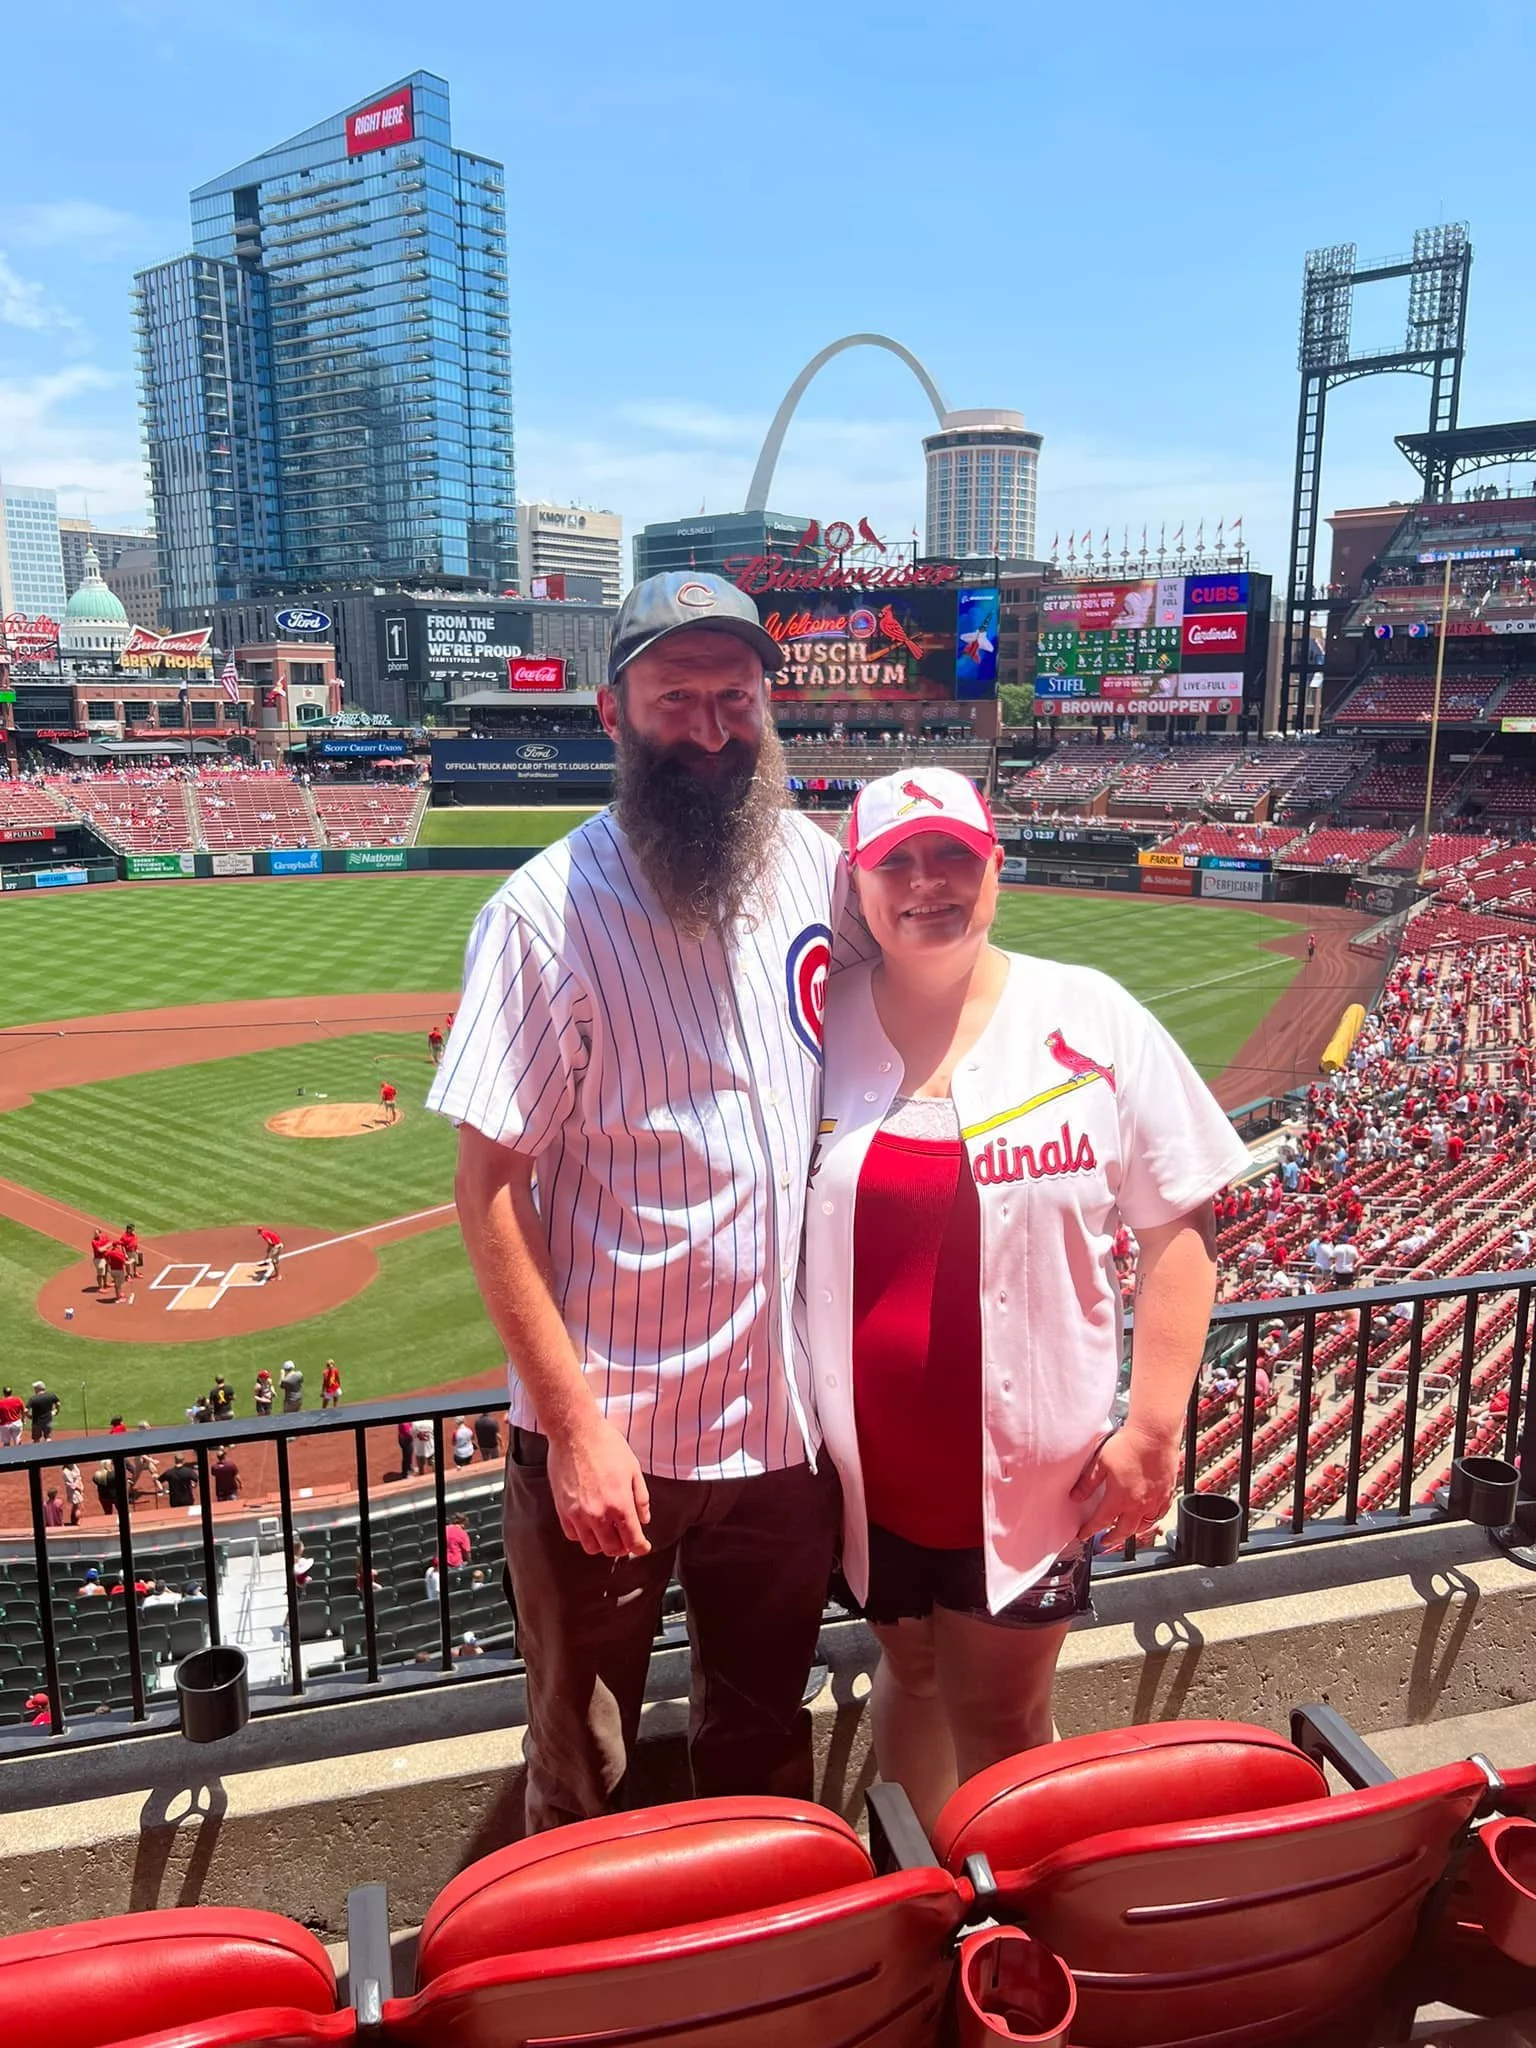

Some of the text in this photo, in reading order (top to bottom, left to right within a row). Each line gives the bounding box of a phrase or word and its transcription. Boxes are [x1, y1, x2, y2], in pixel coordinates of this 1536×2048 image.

[354, 104, 404, 136] RIGHT HERE
[539, 511, 566, 524] KMOV
[723, 553, 962, 594] Budweiser
[1061, 557, 1229, 579] WORLD CHAMPIONS
[676, 582, 716, 608] C
[1191, 586, 1240, 603] CUBS
[1043, 601, 1057, 611] GET
[1059, 601, 1070, 610] UP
[1071, 600, 1082, 609] TO
[1101, 598, 1116, 608] OFF
[288, 611, 320, 628] Ford
[427, 615, 495, 630] FROM THE
[765, 611, 848, 641] Welcome
[128, 633, 211, 651] Budweiser
[427, 629, 487, 643] LOU AND
[1188, 625, 1237, 644] Cardinals
[428, 643, 522, 658] WE'RE PROUD
[120, 654, 213, 669] BREW HOUSE
[388, 662, 409, 672] phorm
[515, 666, 557, 682] Coca-Cola
[775, 664, 905, 686] STADIUM
[1048, 677, 1086, 692] STIFEL
[1183, 681, 1200, 690] LIVE
[1207, 680, 1226, 690] FULL
[1061, 702, 1113, 714] BROWN
[1128, 700, 1210, 714] CROUPPEN
[324, 744, 403, 752] SCOTT CREDIT UNION
[524, 746, 551, 758] Ford
[13, 830, 43, 838] PURINA
[362, 853, 403, 864] National
[1150, 854, 1179, 865] FABICK
[1203, 876, 1259, 892] PERFICIENT
[973, 1121, 1097, 1186] dinals
